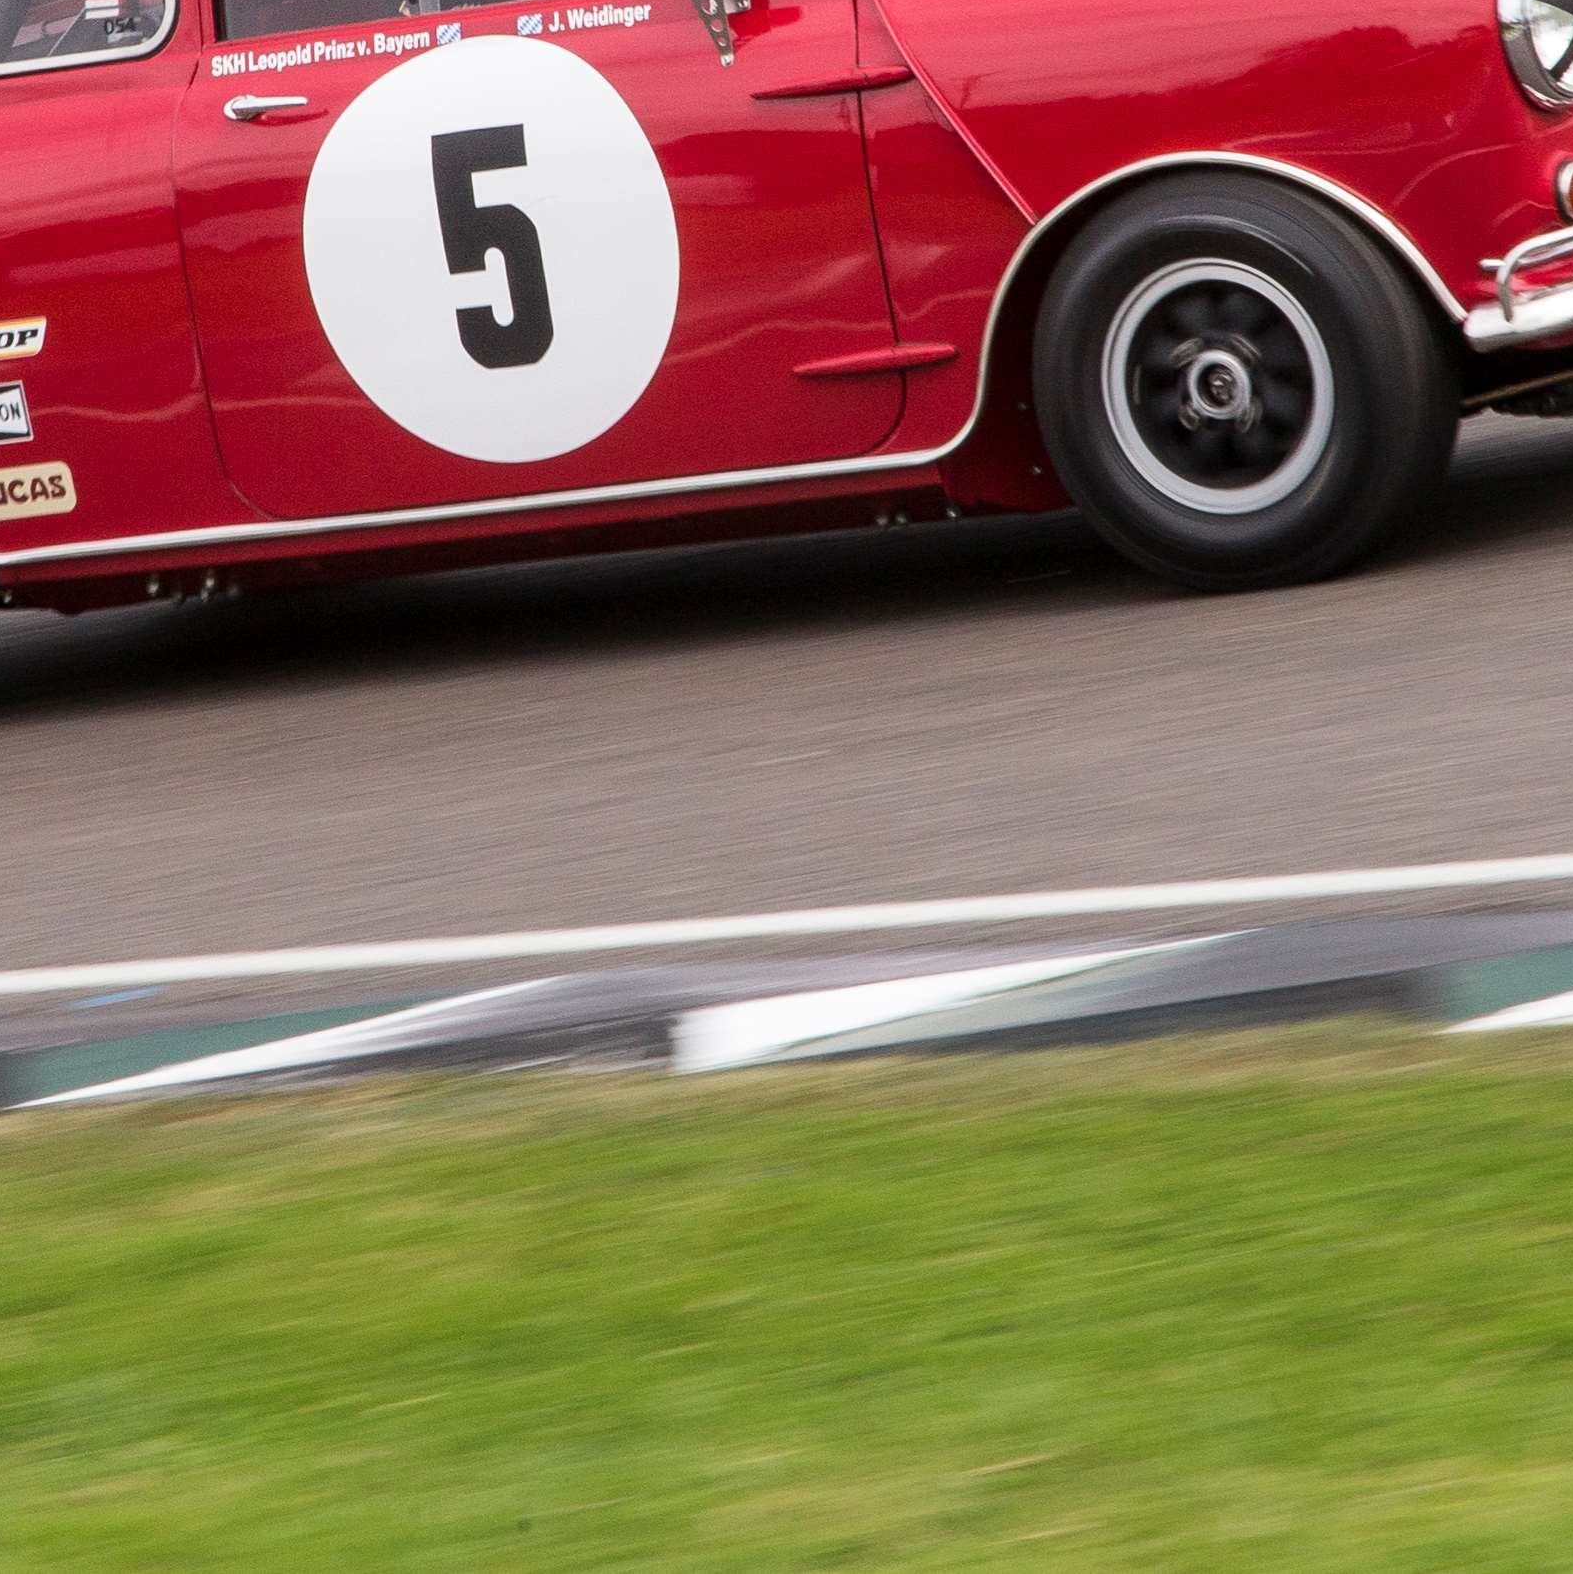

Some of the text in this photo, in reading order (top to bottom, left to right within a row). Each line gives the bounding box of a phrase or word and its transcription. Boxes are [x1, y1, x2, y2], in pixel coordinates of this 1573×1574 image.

[548, 4, 651, 32] J. Weidinger
[211, 31, 430, 77] SKH Leopold Prinz v. Bayern
[431, 123, 554, 369] 5
